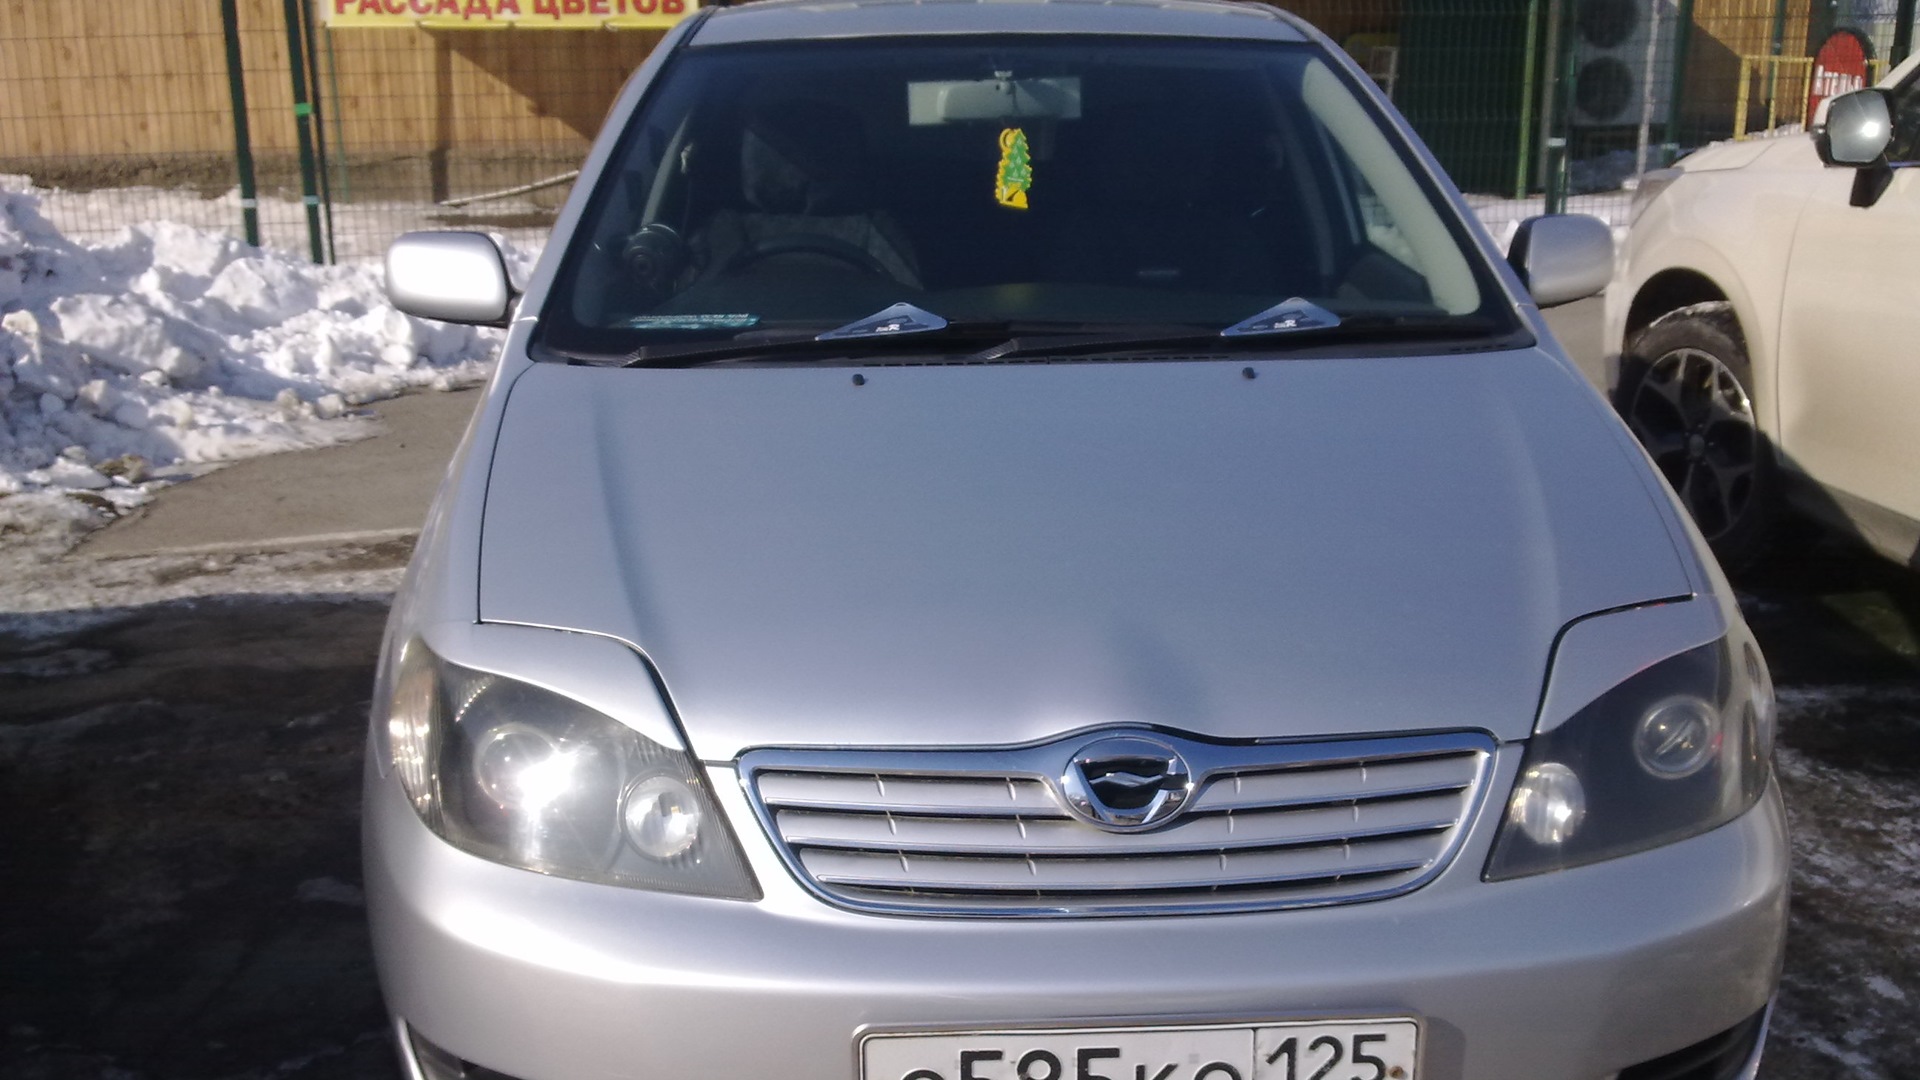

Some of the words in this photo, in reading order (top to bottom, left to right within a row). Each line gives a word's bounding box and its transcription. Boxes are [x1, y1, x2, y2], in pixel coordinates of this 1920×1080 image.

[334, 0, 521, 20] РАССАДА
[534, 0, 685, 20] ЦВЕТОВ
[1266, 1033, 1387, 1080] 125
